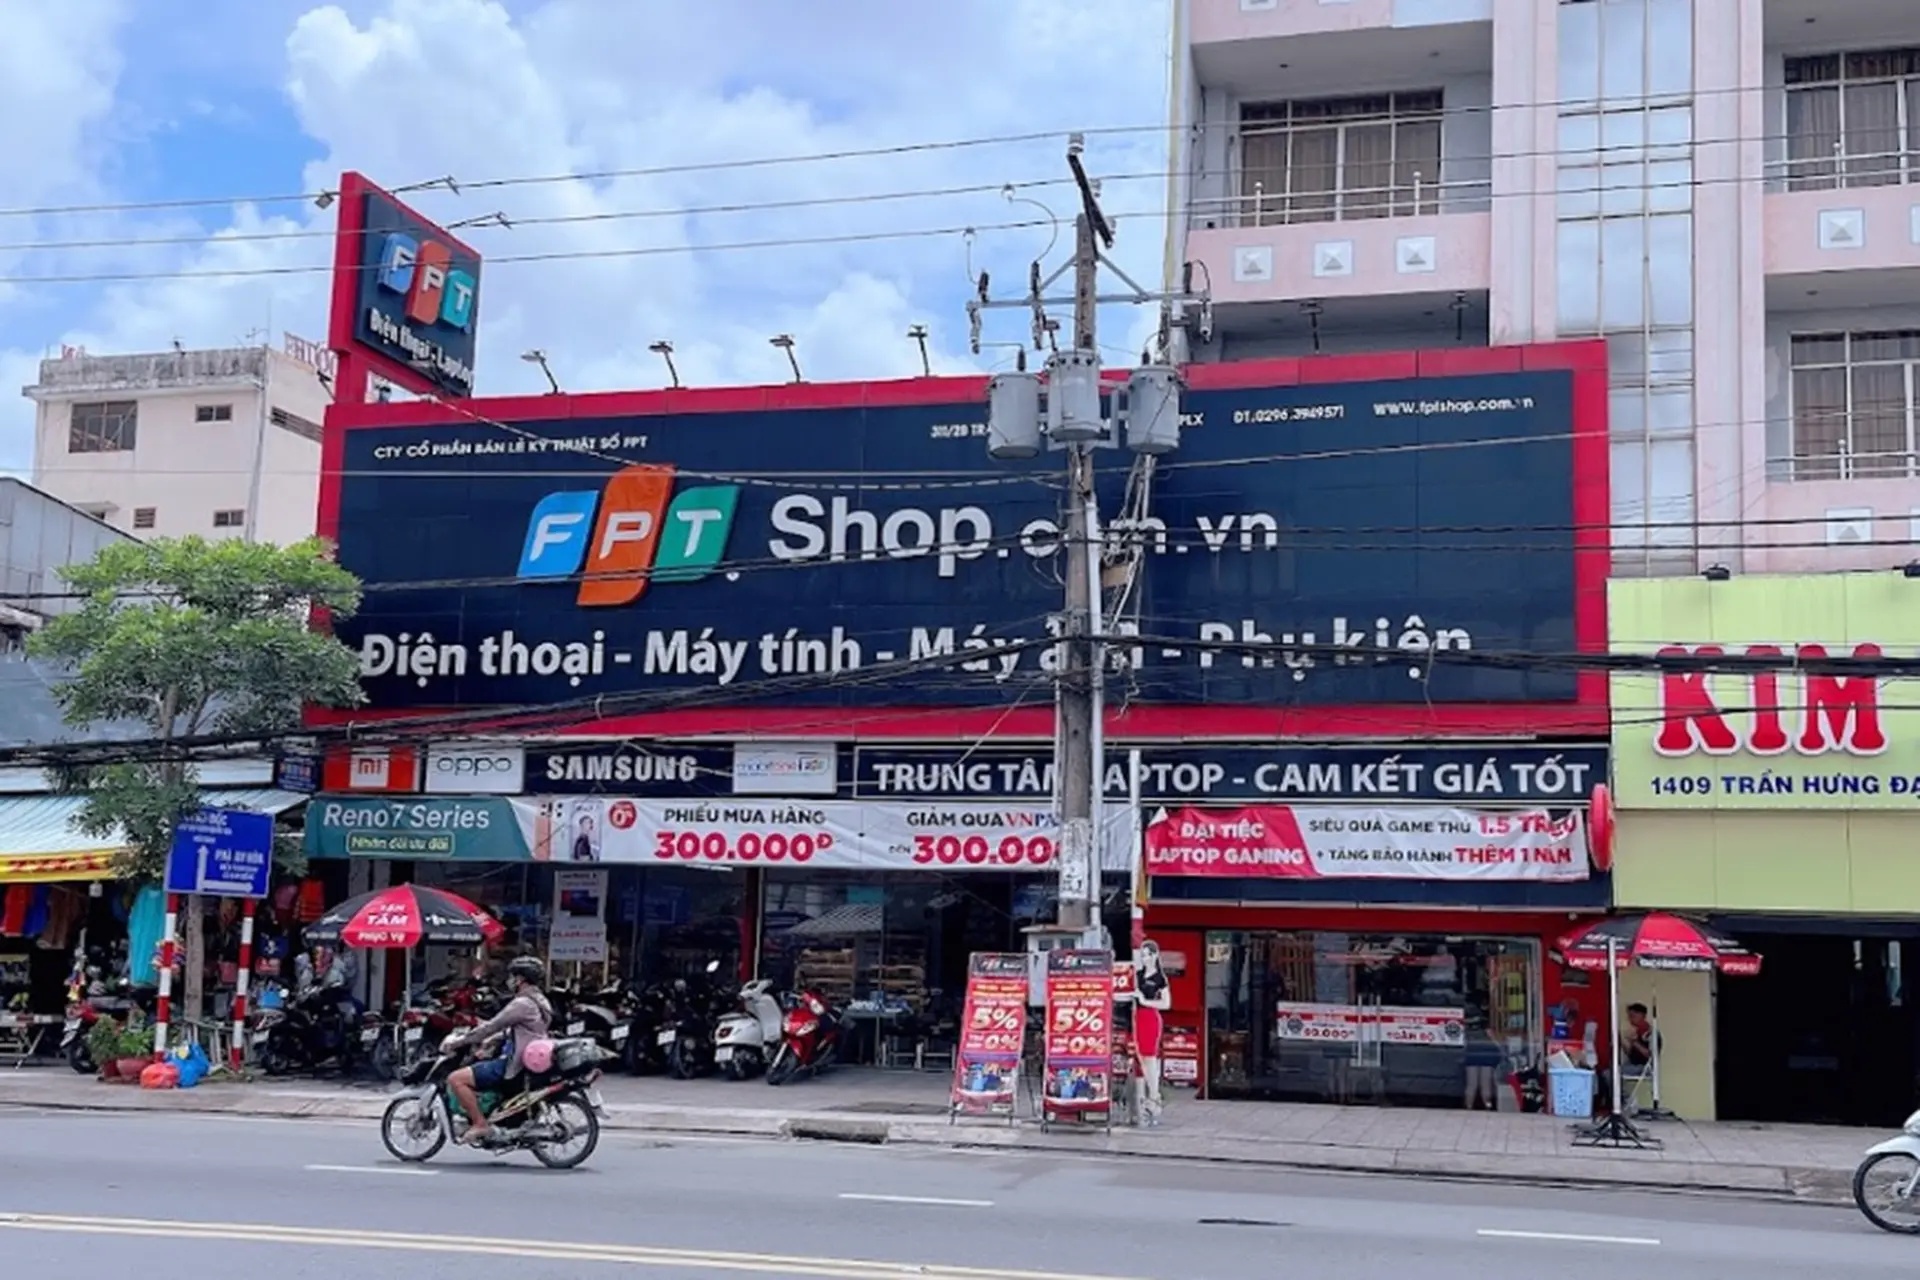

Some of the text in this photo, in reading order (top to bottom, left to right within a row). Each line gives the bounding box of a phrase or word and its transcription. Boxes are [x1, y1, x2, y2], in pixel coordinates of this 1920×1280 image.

[374, 447, 401, 459] CTY
[622, 436, 647, 448] FPT
[769, 493, 1278, 577] Shop.cm.vn
[361, 631, 466, 687] Điện
[479, 630, 604, 687] thoại
[643, 630, 748, 686] Máy
[759, 627, 861, 677] tính
[909, 623, 1025, 683] Máy
[1655, 642, 1888, 756] KIM
[546, 755, 698, 782] SAMSUNG
[872, 764, 993, 793] TRUNG
[1103, 763, 1225, 793] APTOP
[1255, 763, 1341, 793] CAM
[1352, 754, 1426, 793] KẾT
[1434, 756, 1501, 793] GIÁ
[1511, 751, 1589, 793] TỐT
[1651, 776, 1711, 794] 1409
[1721, 769, 1793, 794] TRẦN
[1803, 772, 1880, 795] HƯNG
[323, 804, 490, 828] Reno7 Series
[664, 801, 826, 824] PHIẾU MUA HÀNG
[907, 806, 957, 826] GIẢM
[1388, 820, 1434, 833] GAME
[1479, 815, 1511, 834] 1.5
[1220, 818, 1264, 842] TIỆC
[913, 835, 1060, 864] 300.00
[1150, 848, 1305, 864] LAPTOP GAMING
[1455, 845, 1515, 863] THÊM
[969, 1008, 1019, 1030] 5%
[1053, 1008, 1104, 1032] 5%
